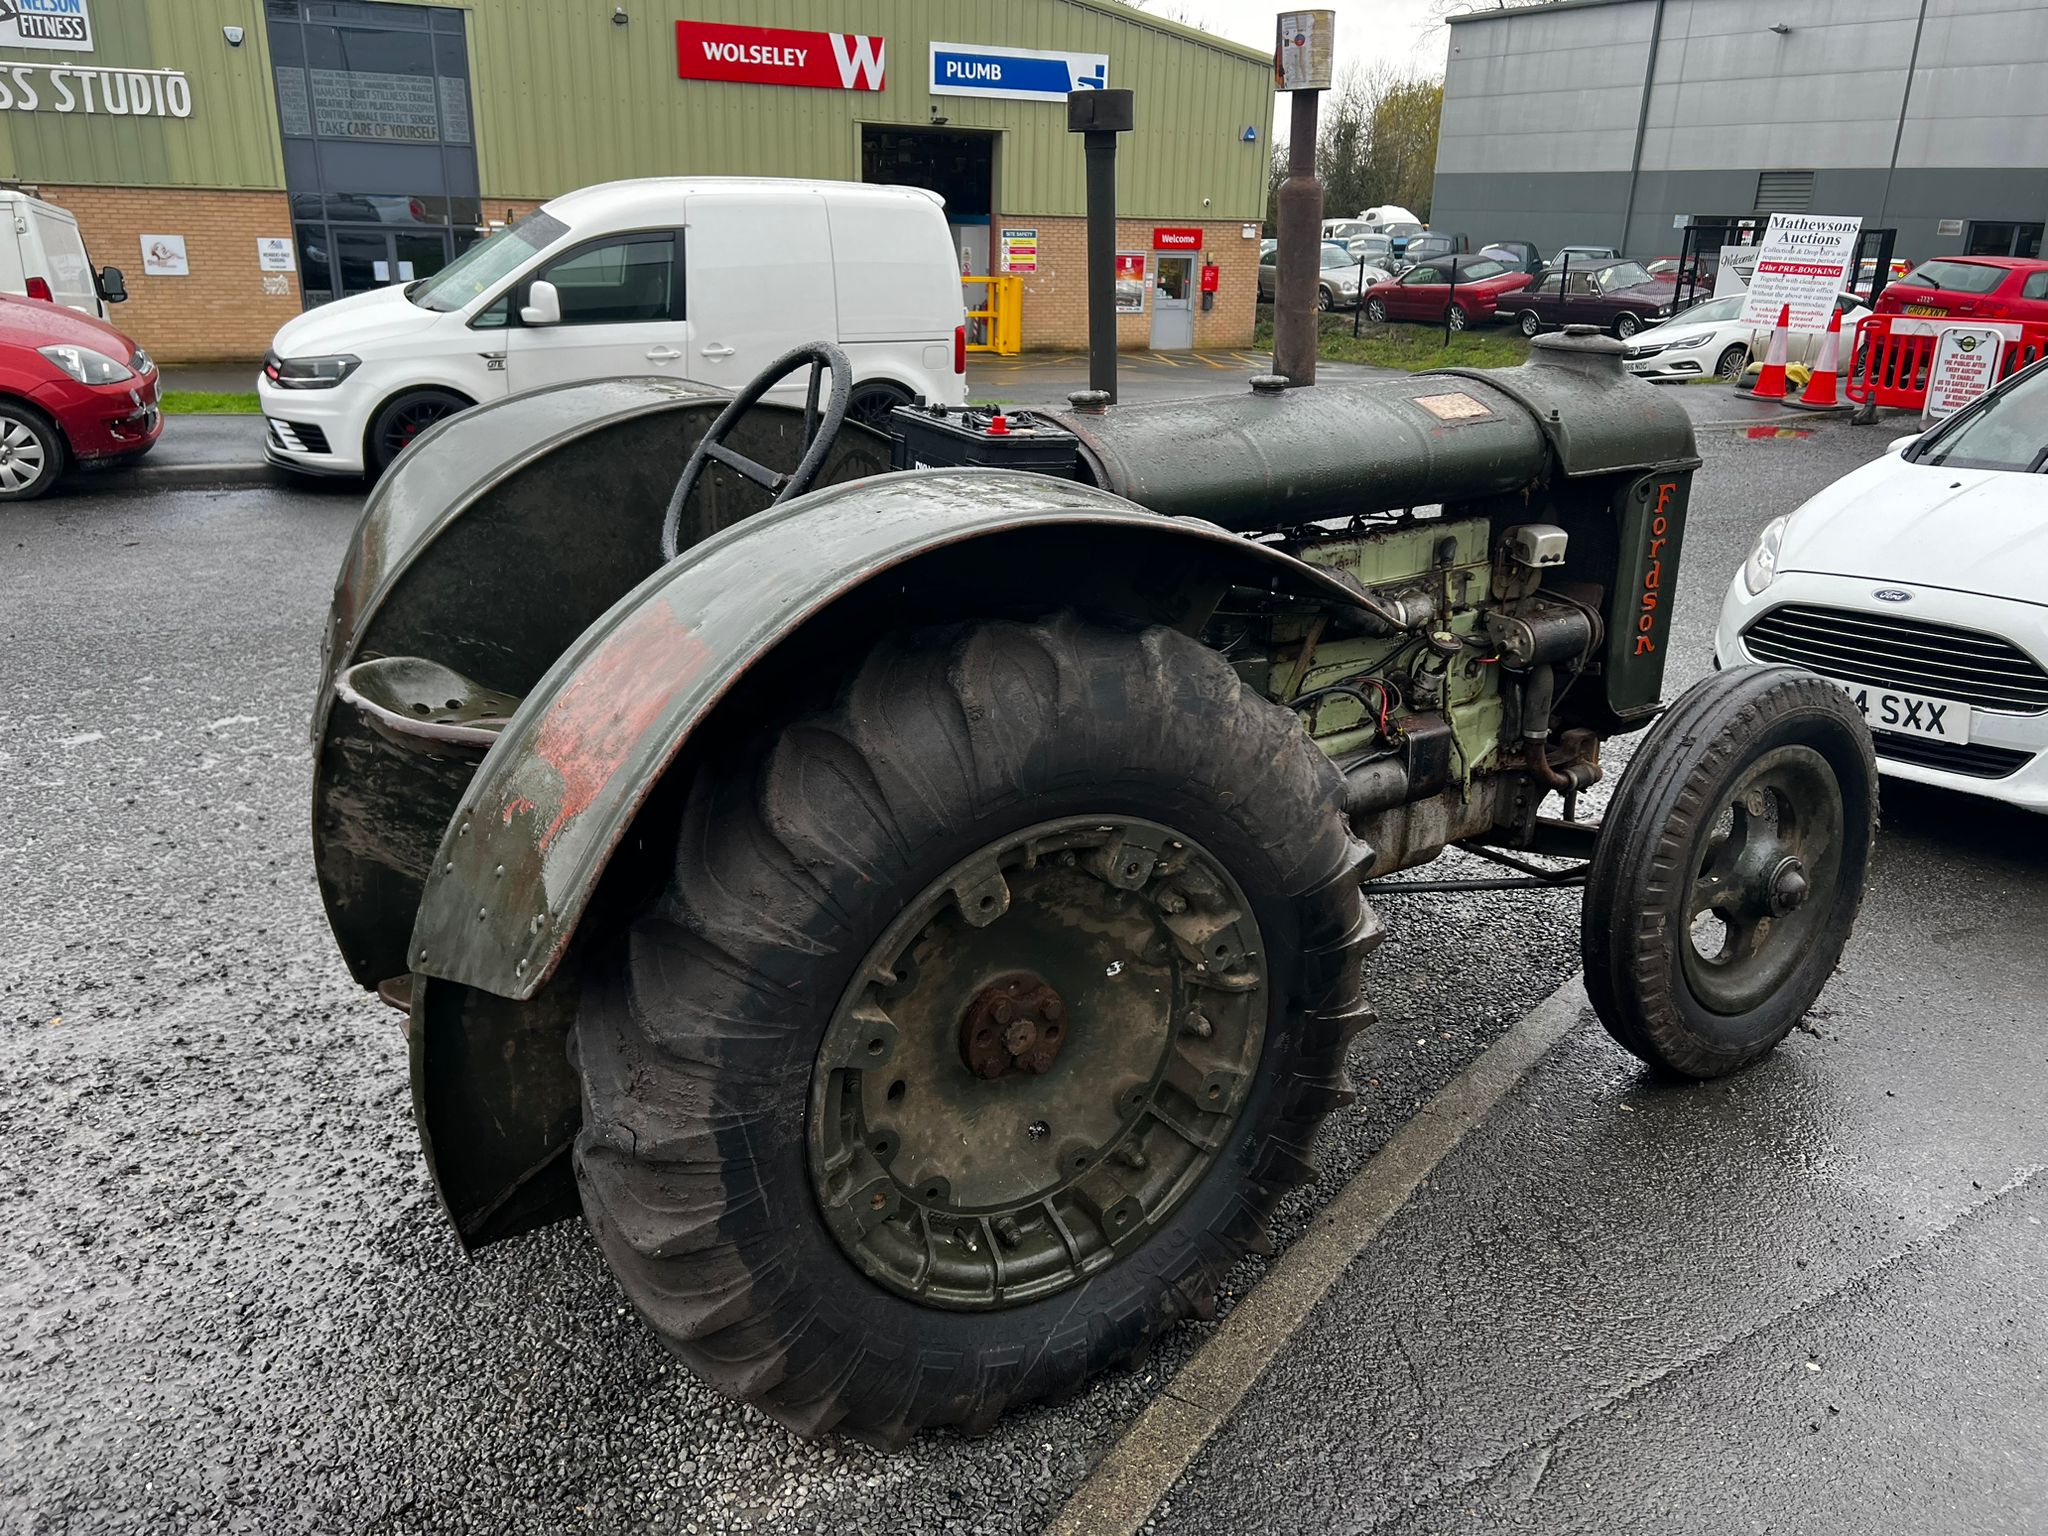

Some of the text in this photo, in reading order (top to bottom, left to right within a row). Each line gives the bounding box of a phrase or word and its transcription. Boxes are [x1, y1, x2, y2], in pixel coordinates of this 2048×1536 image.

[20, 0, 81, 13] NELSON
[21, 14, 83, 39] FITNESS
[702, 41, 808, 67] WOLSELEY
[828, 32, 885, 90] W
[946, 61, 1002, 80] PLUMB
[50, 69, 191, 118] STUDIO
[315, 87, 433, 103] NAMASTE QUIET STILLNESS EXHALE
[316, 98, 343, 108] BREATHE
[369, 101, 394, 111] PILATES
[317, 109, 435, 125] CONTROL INHALE REFLECT SENSES
[319, 121, 436, 139] TAKE CARE OF YOURSELF
[1770, 216, 1859, 233] Mathewsons
[1161, 234, 1195, 243] Welcome
[1777, 231, 1841, 246] Auctions
[1763, 246, 1795, 254] Collections
[1803, 249, 1819, 257] Drop
[1720, 254, 1755, 267] Welcome
[1816, 257, 1836, 265] period
[1759, 263, 1841, 276] 24hr PRE-BOOKING
[1760, 275, 1784, 284] Together
[1751, 290, 1774, 298] Without
[1784, 291, 1802, 299] above
[1753, 283, 1774, 292] writing
[1774, 284, 1789, 292] from
[487, 360, 504, 368] GTE
[1633, 483, 1677, 656] Fordson
[1879, 590, 1907, 601] Ford
[1881, 695, 1947, 735] SXX
